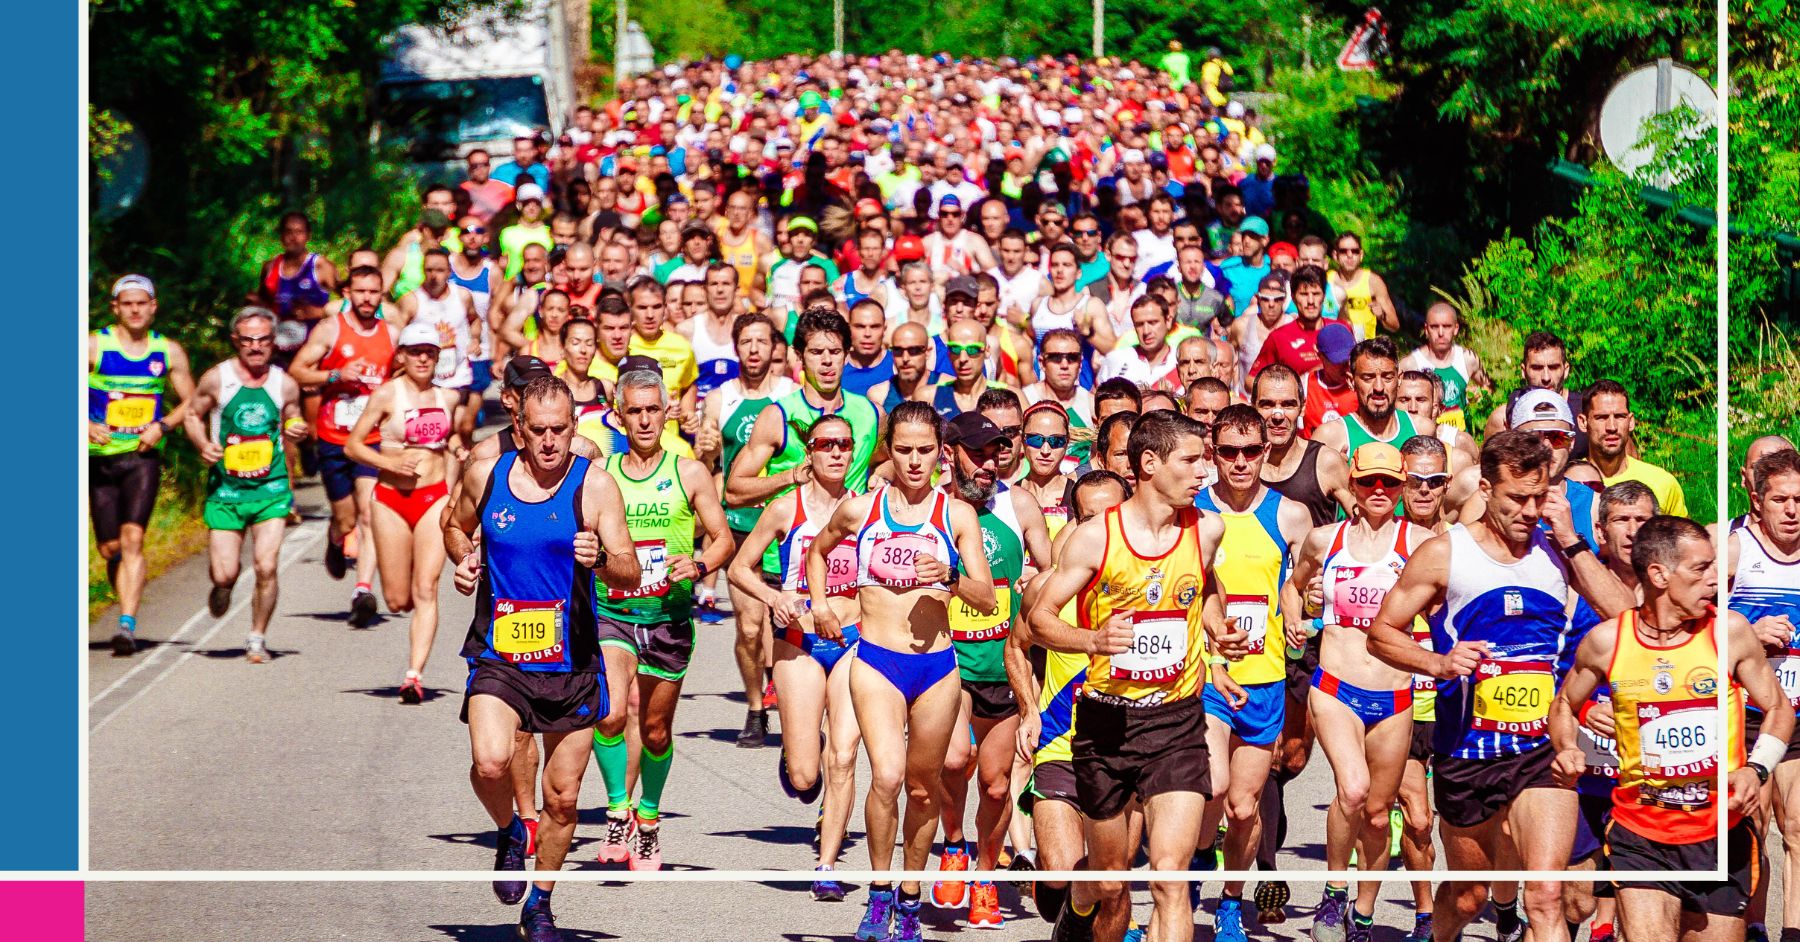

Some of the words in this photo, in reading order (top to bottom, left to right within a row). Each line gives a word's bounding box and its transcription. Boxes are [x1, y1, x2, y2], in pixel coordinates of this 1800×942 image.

[414, 422, 441, 437] 4685
[626, 502, 670, 517] LDAS
[626, 518, 671, 529] ETISMO
[825, 581, 857, 594] OURO
[497, 601, 514, 615] edp
[511, 622, 545, 640] 3119
[966, 620, 1010, 639] DOURO
[512, 644, 562, 662] DOURO
[1131, 660, 1184, 680] DOURO
[1479, 662, 1502, 678] edp
[1493, 685, 1540, 708] 4620
[1655, 725, 1707, 749] 4686
